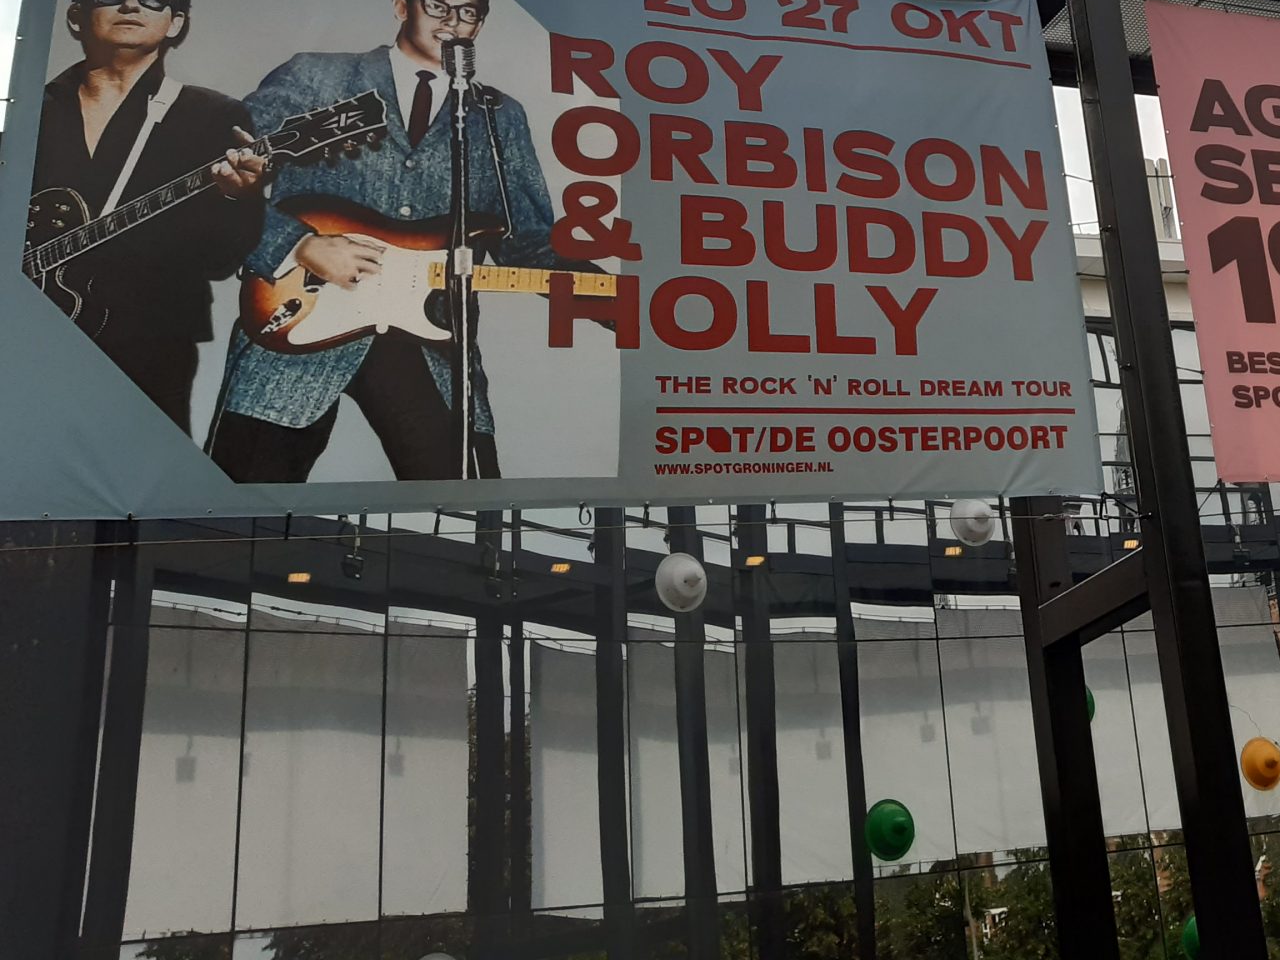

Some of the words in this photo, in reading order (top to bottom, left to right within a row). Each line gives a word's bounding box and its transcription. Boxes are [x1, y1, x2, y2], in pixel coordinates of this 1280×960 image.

[891, 2, 1024, 53] OKT
[549, 31, 783, 112] ROY
[551, 105, 1048, 211] ORBISON
[549, 180, 643, 262] &
[680, 193, 1049, 281] BUDDY
[548, 272, 939, 356] HOLLY
[655, 376, 712, 394] THE
[722, 376, 797, 395] ROCK
[847, 378, 910, 397] ROLL
[920, 379, 1002, 397] DREAM
[1012, 380, 1072, 398] TOUR
[654, 461, 834, 476] WWW.SPOTGRONINGEN.NL
[827, 425, 1068, 453] OOSTERPOORT
